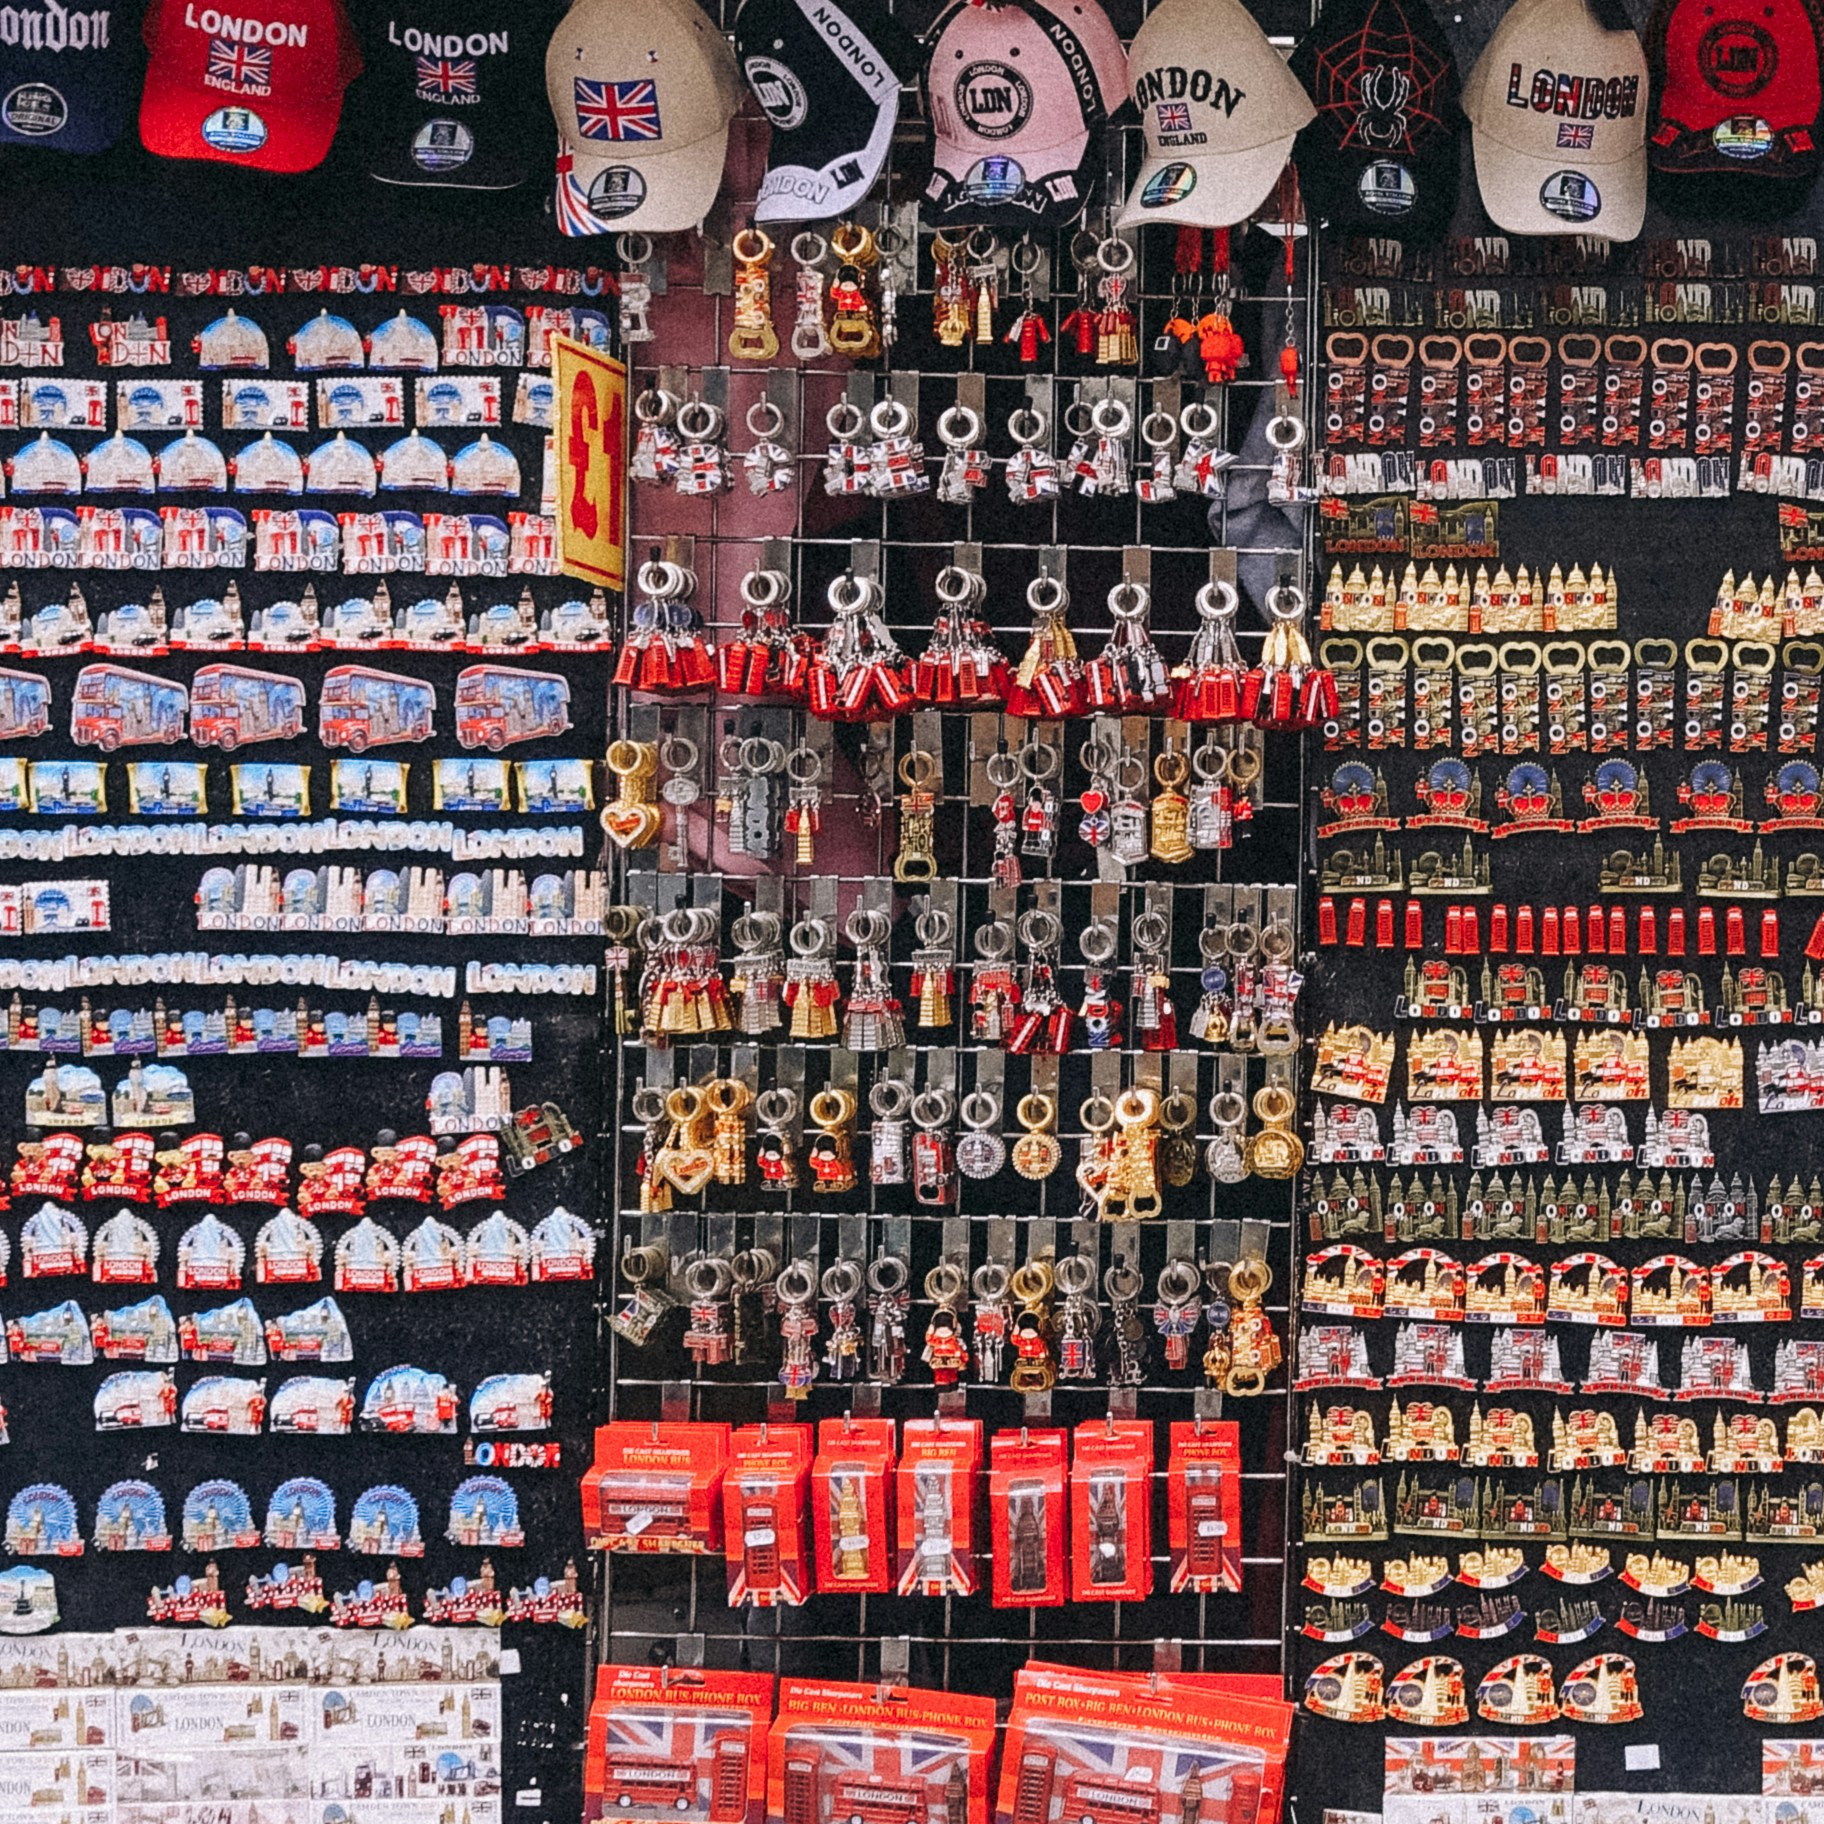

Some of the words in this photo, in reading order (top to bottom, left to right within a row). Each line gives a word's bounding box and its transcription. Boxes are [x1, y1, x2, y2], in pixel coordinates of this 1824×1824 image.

[185, 3, 307, 47] LONDON
[388, 21, 509, 57] LONDON
[812, 6, 884, 88] LONDON
[1050, 23, 1098, 113] LONDON
[204, 74, 271, 96] ENGLAND
[1507, 63, 1639, 121] LONDON
[416, 89, 481, 104] ENGLAND
[969, 86, 1014, 114] LDN
[1157, 132, 1208, 147] ENGLAND
[443, 348, 522, 367] LONDON
[569, 368, 623, 547] £1
[1325, 539, 1407, 553] LONDON
[1413, 544, 1497, 558] LONDON
[0, 552, 78, 568] LONDON
[79, 553, 160, 569] LONDON
[163, 552, 244, 568] LONDON
[255, 554, 337, 571] LONDON
[343, 555, 425, 572] LONDON
[425, 558, 507, 576] LONDON
[200, 916, 280, 931] LONDON
[282, 915, 361, 930] LONDON
[364, 915, 443, 932] LONDON
[449, 917, 527, 933] LONDON
[18, 1183, 64, 1195] LONDON
[91, 1186, 137, 1196] LONDON
[165, 1188, 211, 1201] LONDON
[231, 1190, 277, 1201] LONDON
[374, 1186, 421, 1198] LONDON
[447, 1186, 493, 1204] LONDON
[307, 1200, 353, 1212] LONDON
[623, 1454, 668, 1465] LONDON
[181, 1633, 245, 1654] LONDON
[373, 1633, 438, 1653] LONDON
[611, 1687, 663, 1701] LONDON
[665, 1689, 687, 1701] BUS
[692, 1690, 733, 1703] PHONE
[736, 1693, 761, 1704] BOX
[367, 1714, 416, 1727] LONDON
[788, 1699, 809, 1711] BIG
[812, 1702, 836, 1714] BEN
[844, 1703, 894, 1717] LONDON
[897, 1706, 917, 1718] BUS
[922, 1709, 960, 1723] PHONE
[965, 1714, 988, 1727] BOX
[1025, 1692, 1055, 1705] POST
[1057, 1695, 1080, 1708] BOX
[1086, 1698, 1106, 1712] BIG
[1109, 1701, 1131, 1714] BEN
[1136, 1704, 1184, 1723] LONDON
[1186, 1712, 1208, 1727] BUS
[1213, 1718, 1251, 1734] PHONE
[1254, 1725, 1277, 1739] BOX
[174, 1718, 224, 1730] LONDON
[628, 1770, 675, 1780] LONDON
[857, 1791, 904, 1803] LONDON
[1091, 1790, 1138, 1806] LONDON
[1637, 1799, 1700, 1821] LONDON
